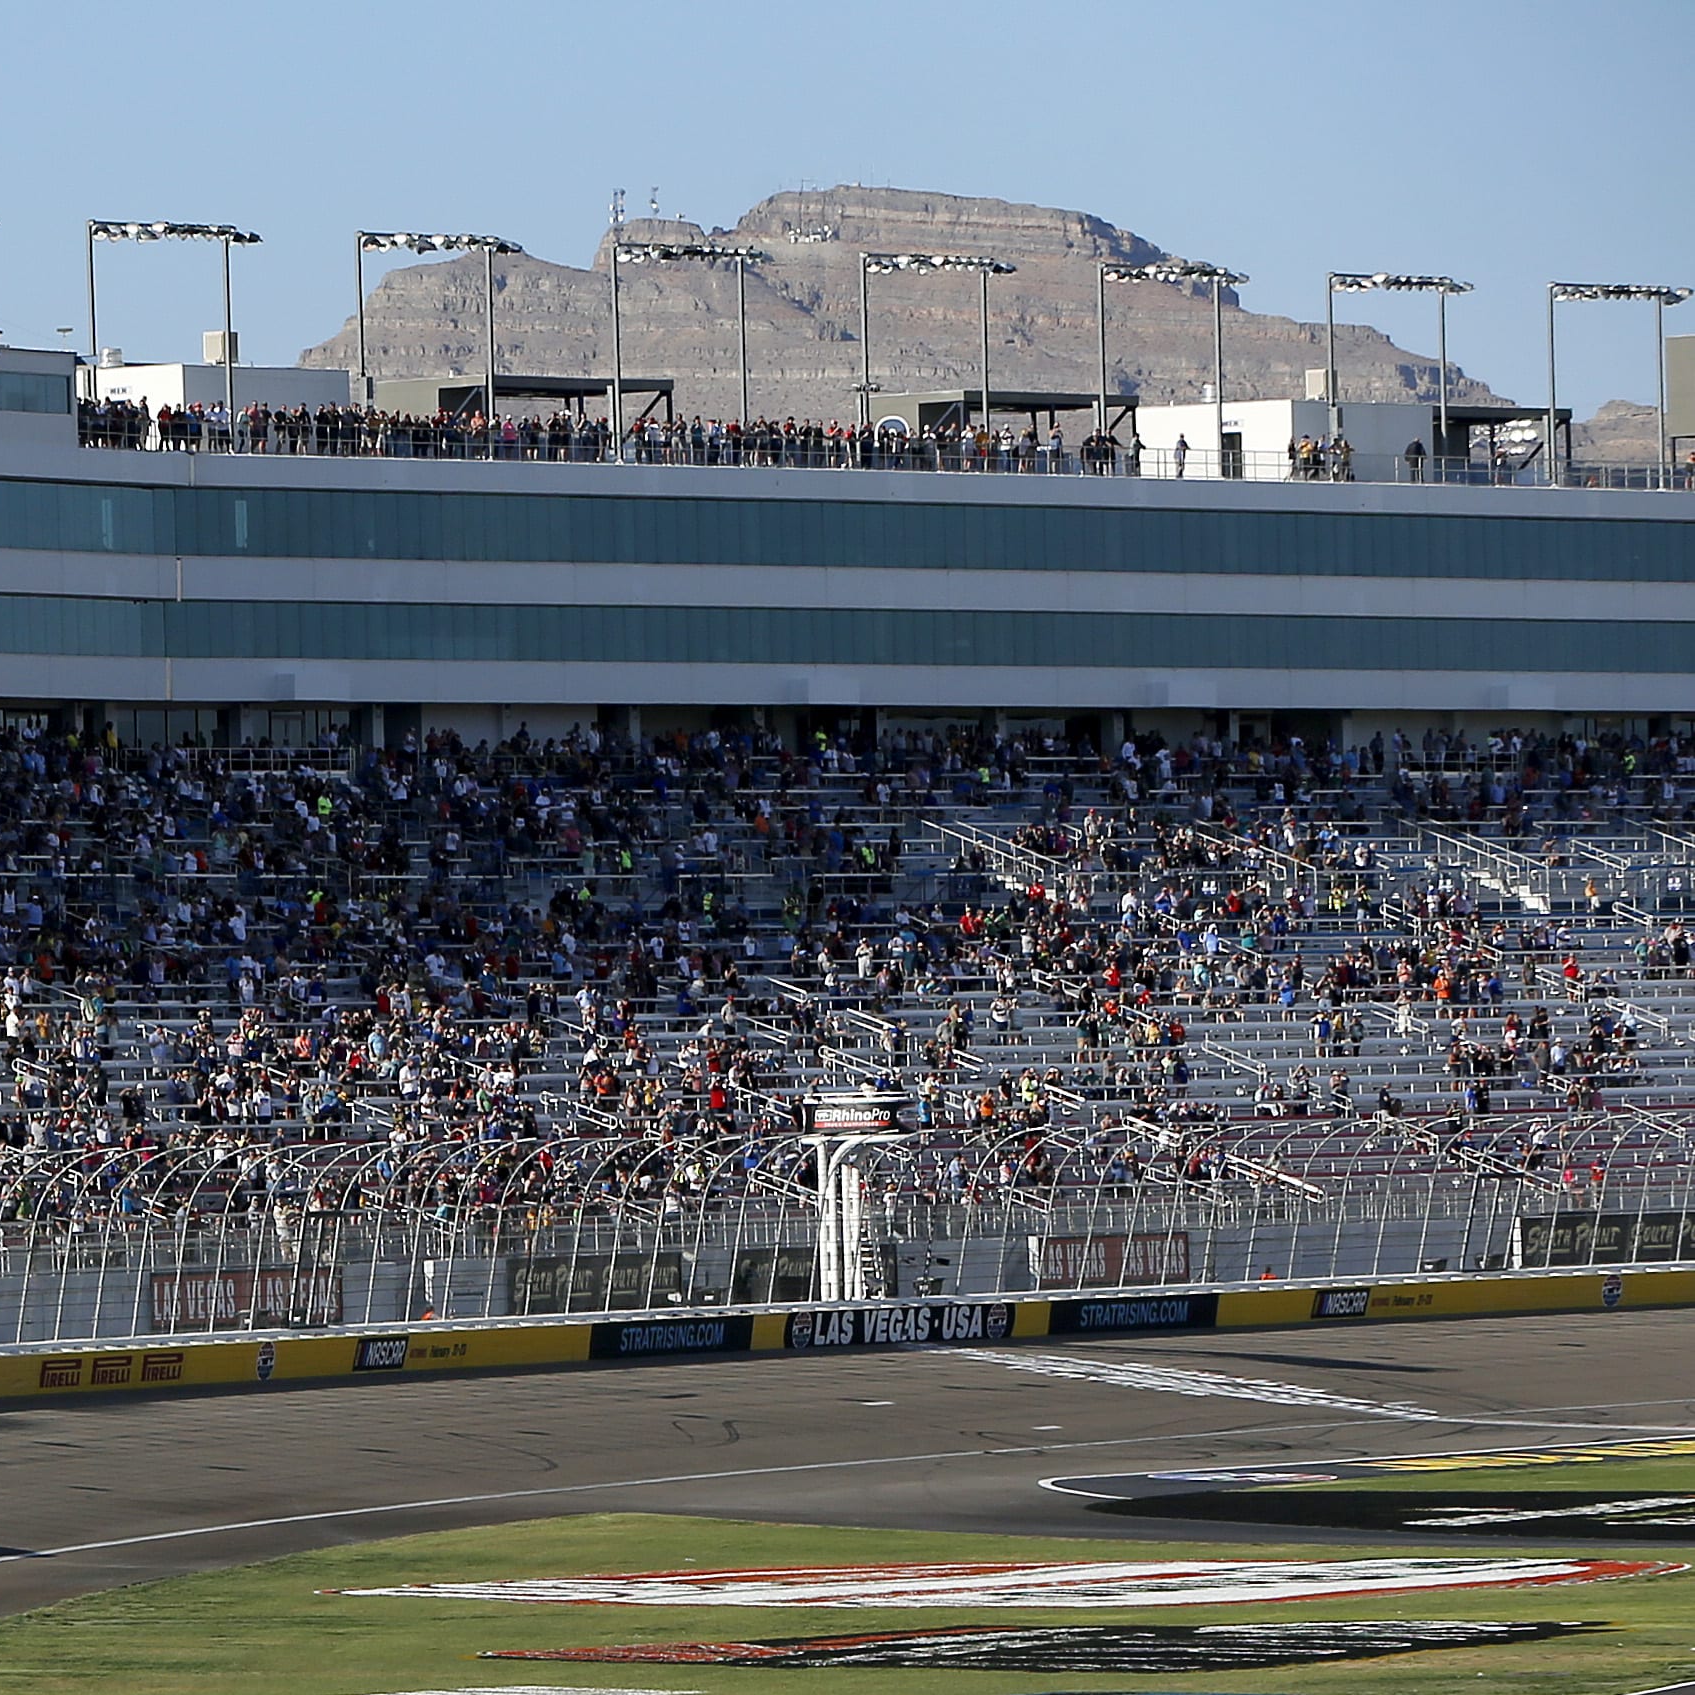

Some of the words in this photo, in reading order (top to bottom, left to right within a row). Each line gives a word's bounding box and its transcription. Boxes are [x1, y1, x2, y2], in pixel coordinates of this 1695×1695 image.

[1068, 1244, 1106, 1278] VEGAS
[1147, 1240, 1185, 1274] VEGAS
[1080, 1301, 1188, 1327] STRATRISING.COM
[1324, 1291, 1368, 1314] NASCAR
[620, 1323, 724, 1352] STRATRISING.COM
[814, 1313, 853, 1345] LAS
[864, 1308, 930, 1342] VEGAS
[942, 1307, 983, 1340] USA
[142, 1352, 184, 1382] PIRELLI
[365, 1341, 407, 1366] NASCAR
[40, 1359, 82, 1388] PIRELLI
[92, 1355, 132, 1385] PIRELLI
